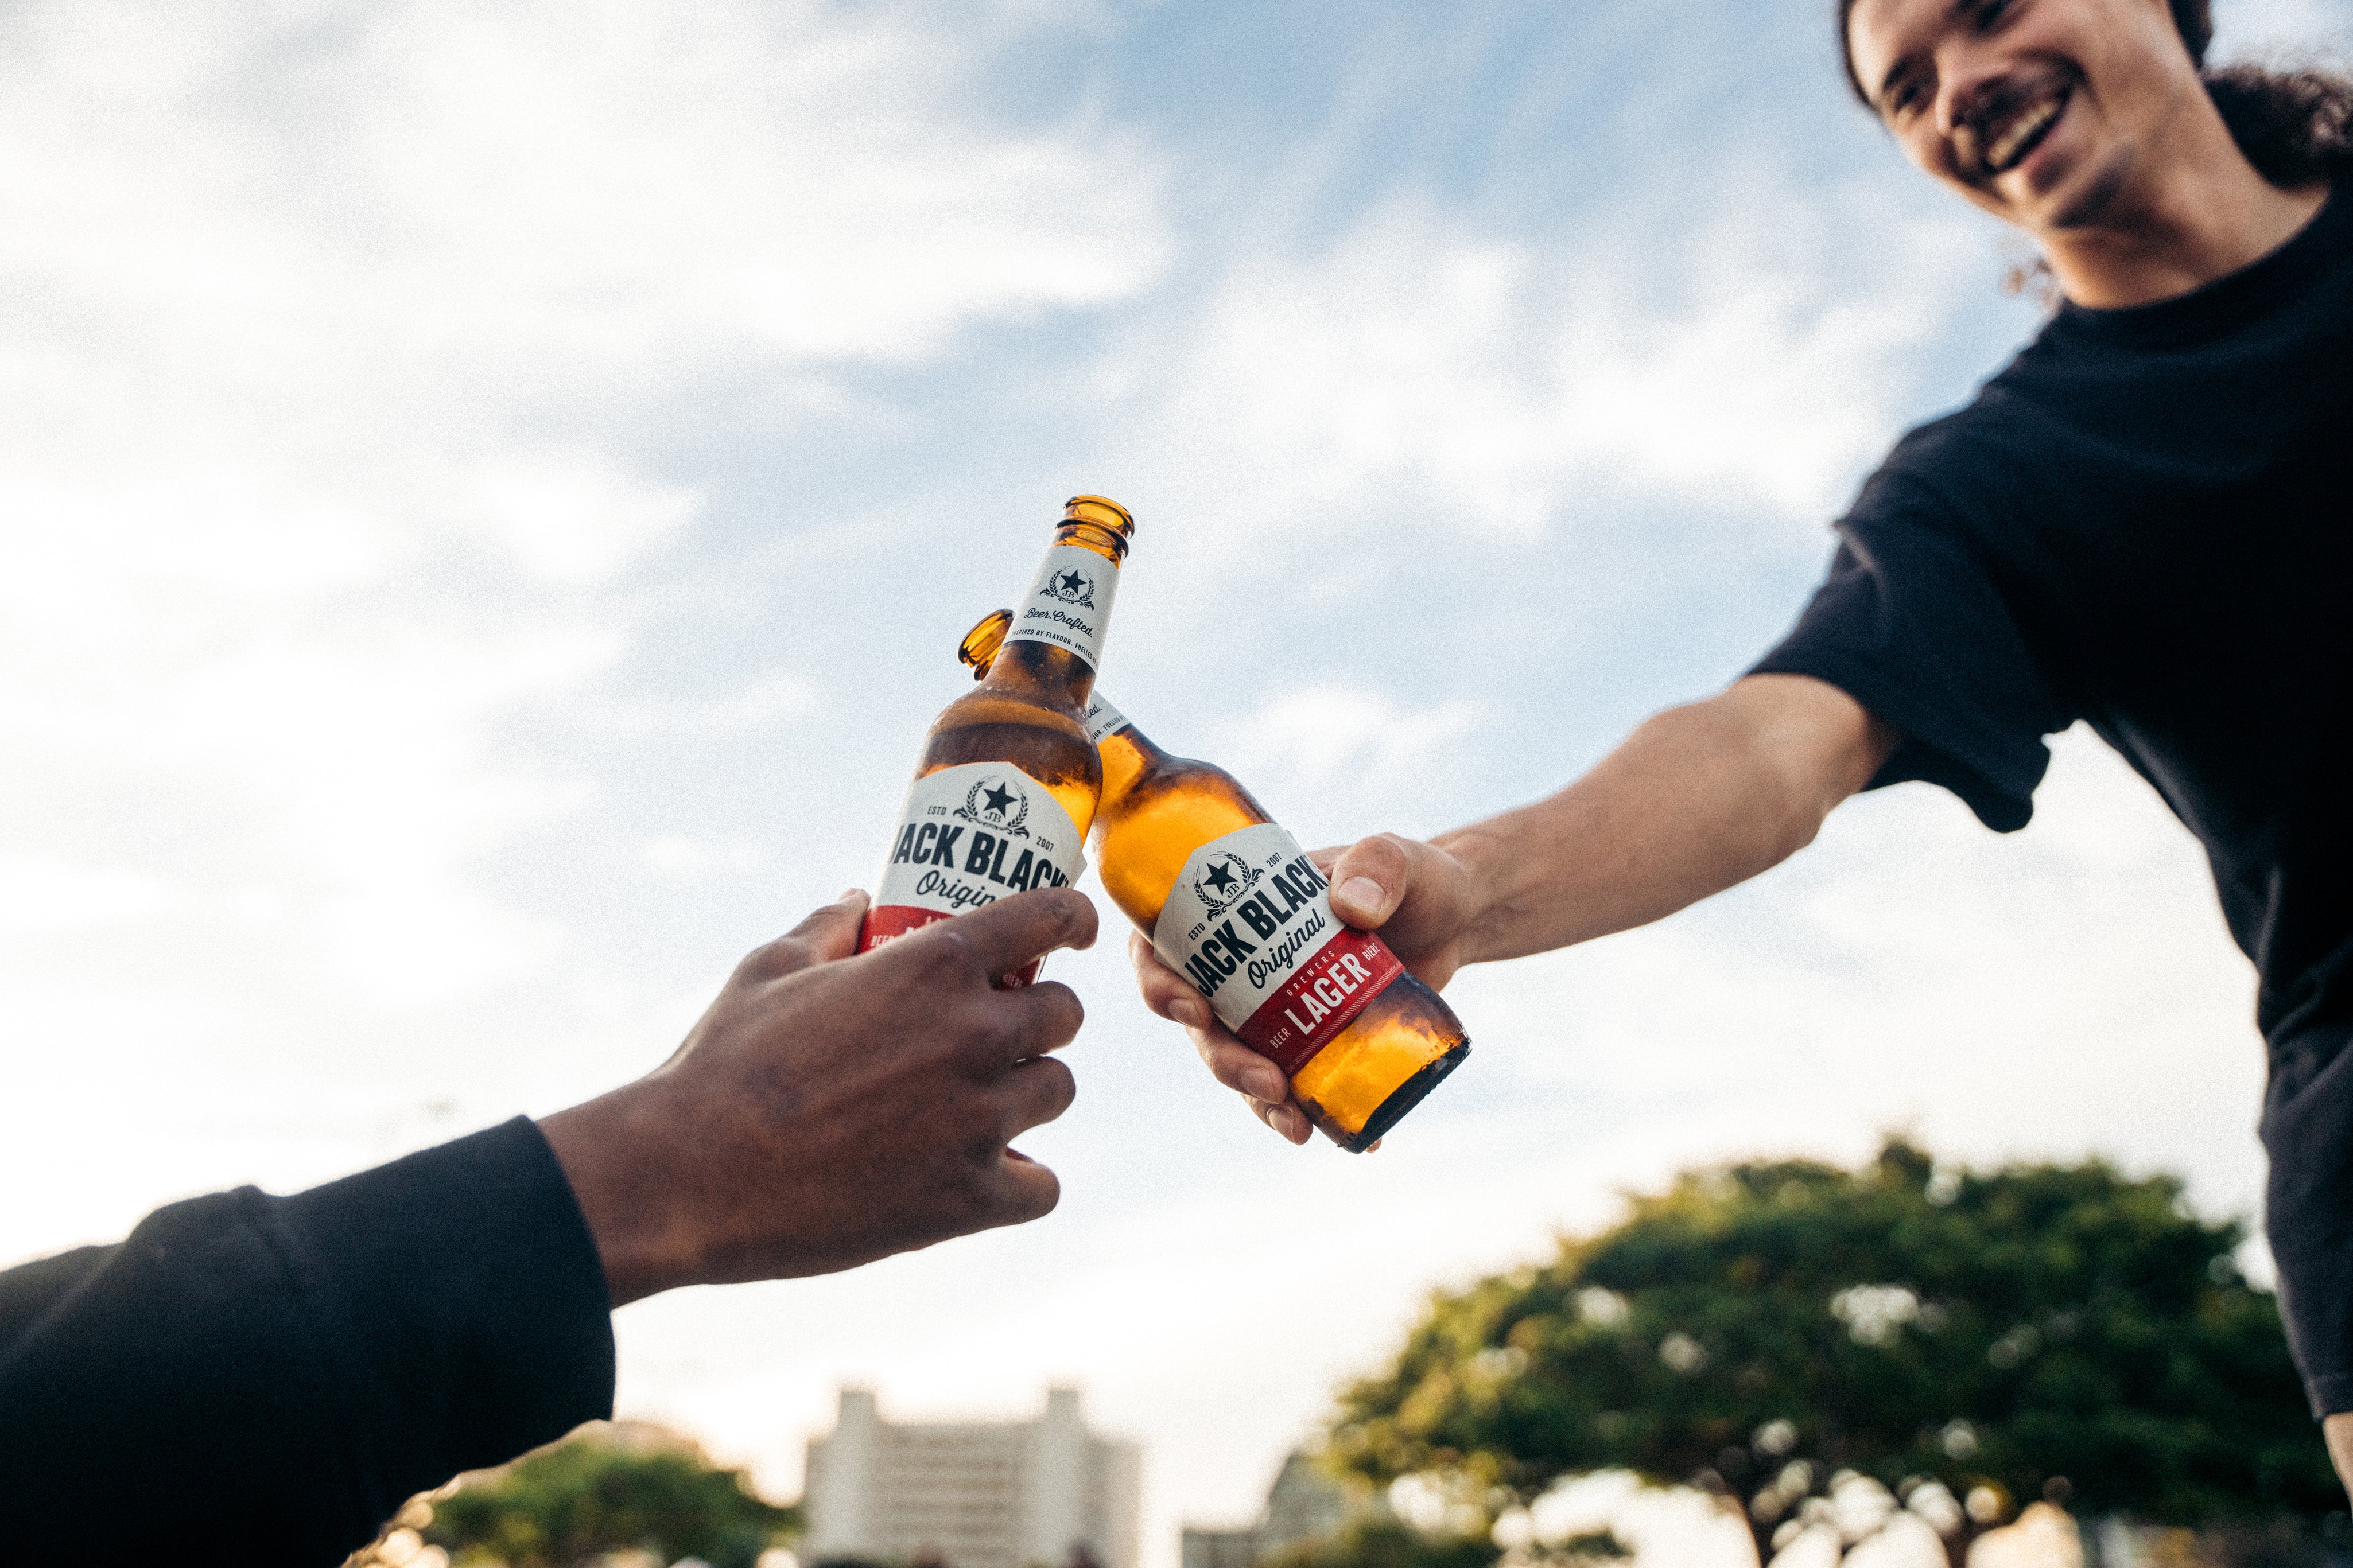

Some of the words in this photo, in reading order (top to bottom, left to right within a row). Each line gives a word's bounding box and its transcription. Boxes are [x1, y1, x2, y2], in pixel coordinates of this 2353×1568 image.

[1062, 590, 1075, 598] JB
[1046, 632, 1073, 646] FLAVOUR.
[1075, 643, 1093, 660] FUELLED
[1103, 717, 1120, 730] FUELLED
[927, 806, 947, 815] ESTD
[985, 811, 1002, 823] JB
[1036, 836, 1054, 852] 2007
[1266, 853, 1282, 868] 2007
[917, 870, 996, 909] Origin
[1225, 884, 1240, 898] JB
[1184, 919, 1257, 998] JACK
[1236, 855, 1329, 941] BLACK
[1188, 923, 1206, 940] ESTD
[1248, 908, 1325, 989] Original
[1286, 950, 1335, 997] BREWERS
[1270, 1028, 1291, 1049] BEER
[1284, 952, 1372, 1035] LAGER
